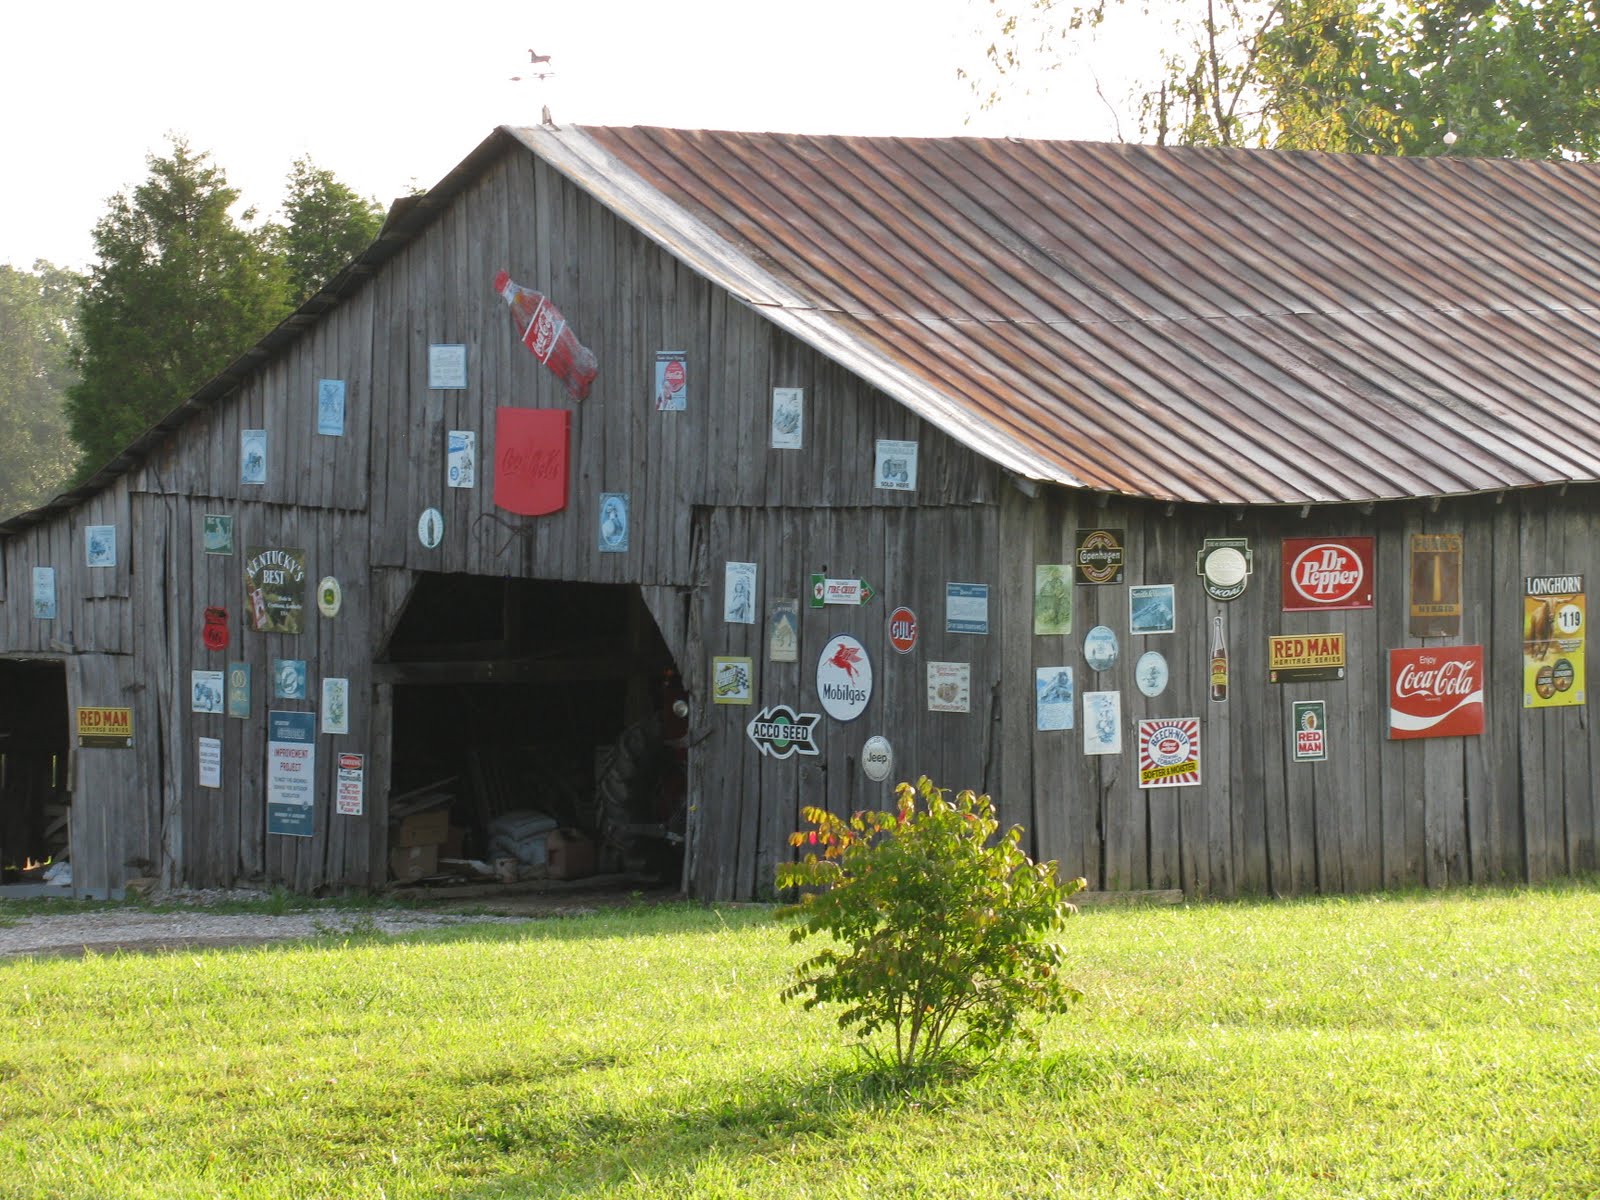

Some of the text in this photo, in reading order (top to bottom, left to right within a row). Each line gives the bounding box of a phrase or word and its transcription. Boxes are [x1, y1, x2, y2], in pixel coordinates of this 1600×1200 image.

[1080, 550, 1120, 564] Copenhagen
[1319, 549, 1347, 571] Dr
[246, 550, 304, 582] KENTUCKY'S
[263, 570, 285, 585] BEST
[1300, 561, 1358, 595] Pepper
[1527, 577, 1582, 594] LONGHORN
[1209, 586, 1241, 597] SKOAL
[892, 621, 916, 641] GULF
[1274, 638, 1340, 658] RED MAN
[1273, 656, 1341, 666] HERITAGE SERIES
[1419, 656, 1437, 665] Enjoy
[1396, 660, 1476, 698] Coca-Cola
[823, 684, 867, 706] Mobilgas
[80, 710, 128, 727] RED MAN
[753, 723, 809, 741] ACCO SEED
[1151, 728, 1189, 747] BEECH-NUT
[1298, 732, 1321, 742] RED
[274, 749, 309, 759] IMPROVEMENT
[1298, 742, 1322, 753] MAN
[867, 752, 888, 765] Jeep
[280, 762, 302, 773] PROJECT
[1143, 769, 1166, 780] SOFTER
[1170, 762, 1196, 774] MOISTER
